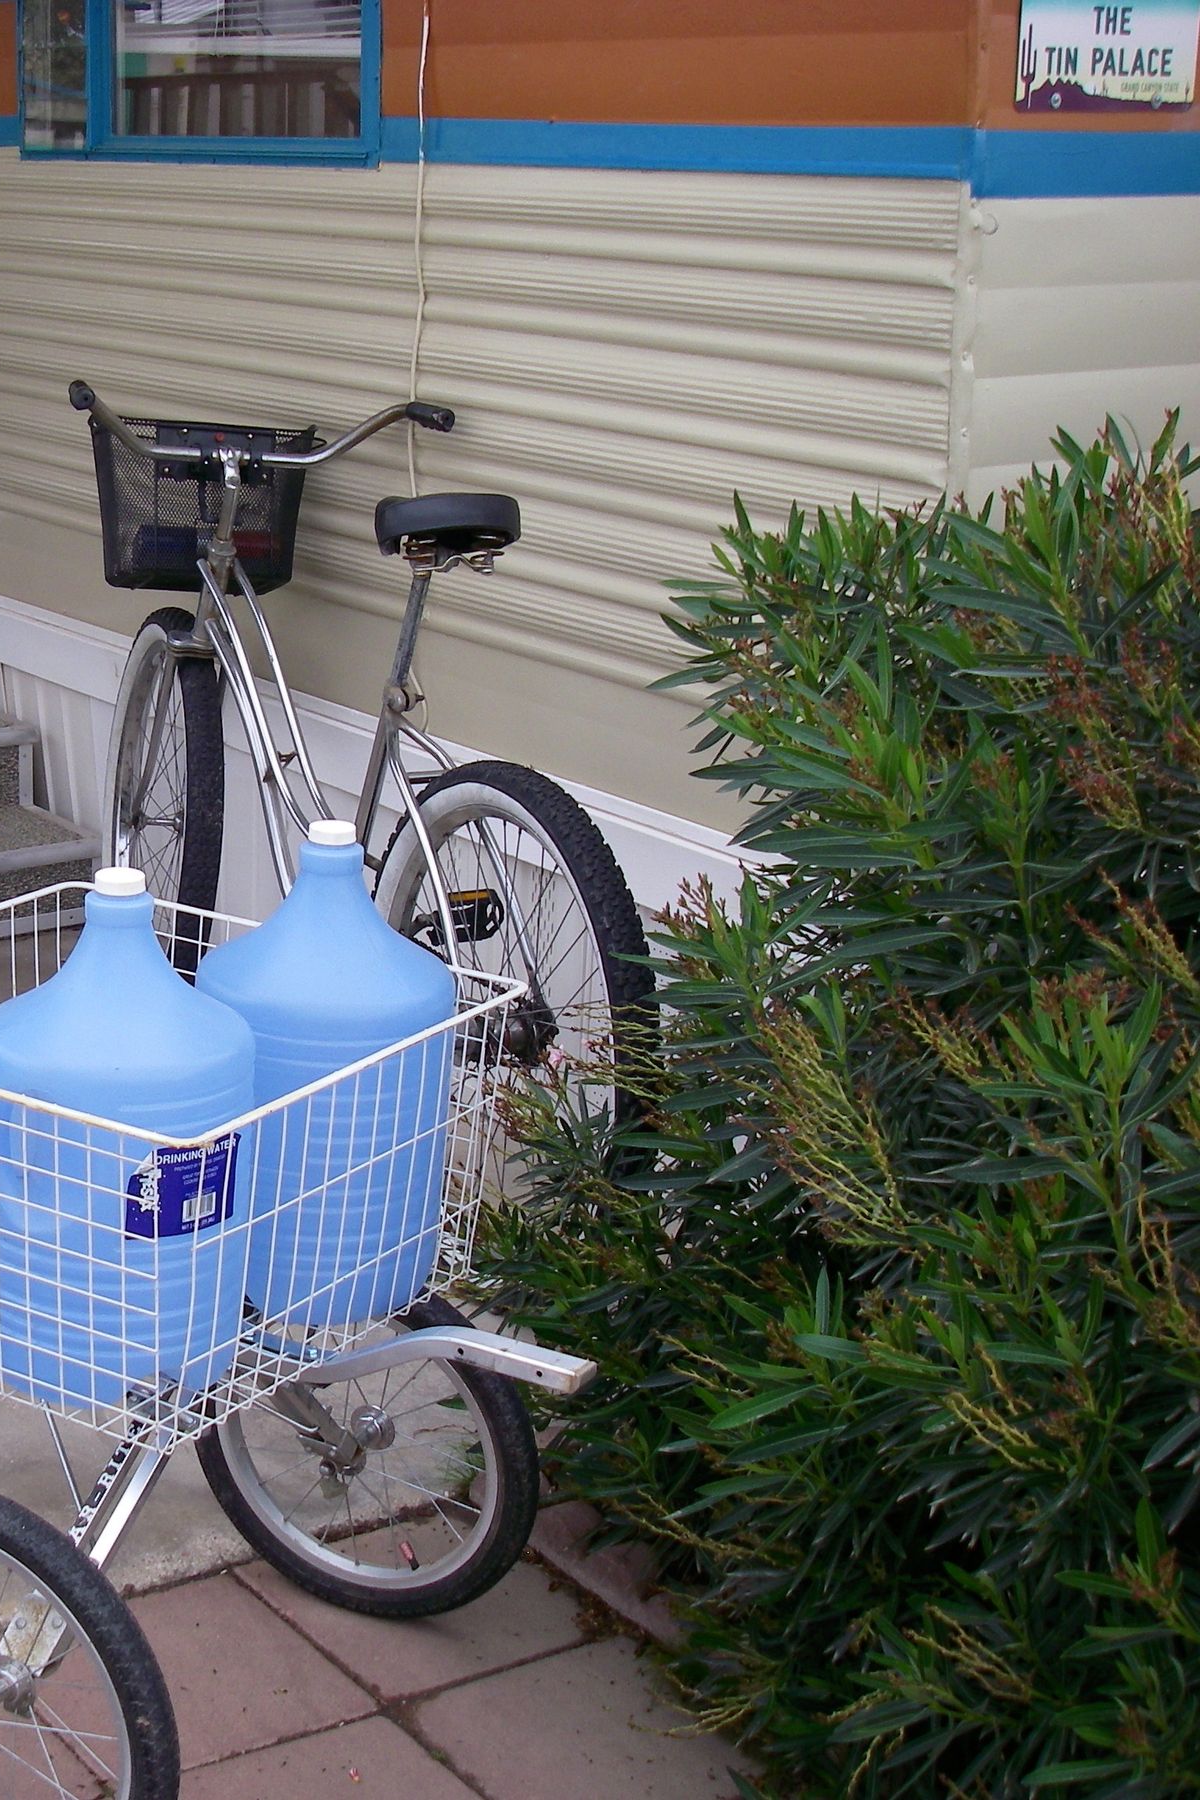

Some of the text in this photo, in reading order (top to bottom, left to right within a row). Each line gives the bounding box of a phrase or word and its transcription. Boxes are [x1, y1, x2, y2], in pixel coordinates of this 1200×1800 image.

[1093, 6, 1133, 36] THE
[1045, 47, 1174, 77] TIN PALACE
[157, 1149, 205, 1165] DRINKING
[207, 1139, 237, 1155] WATER
